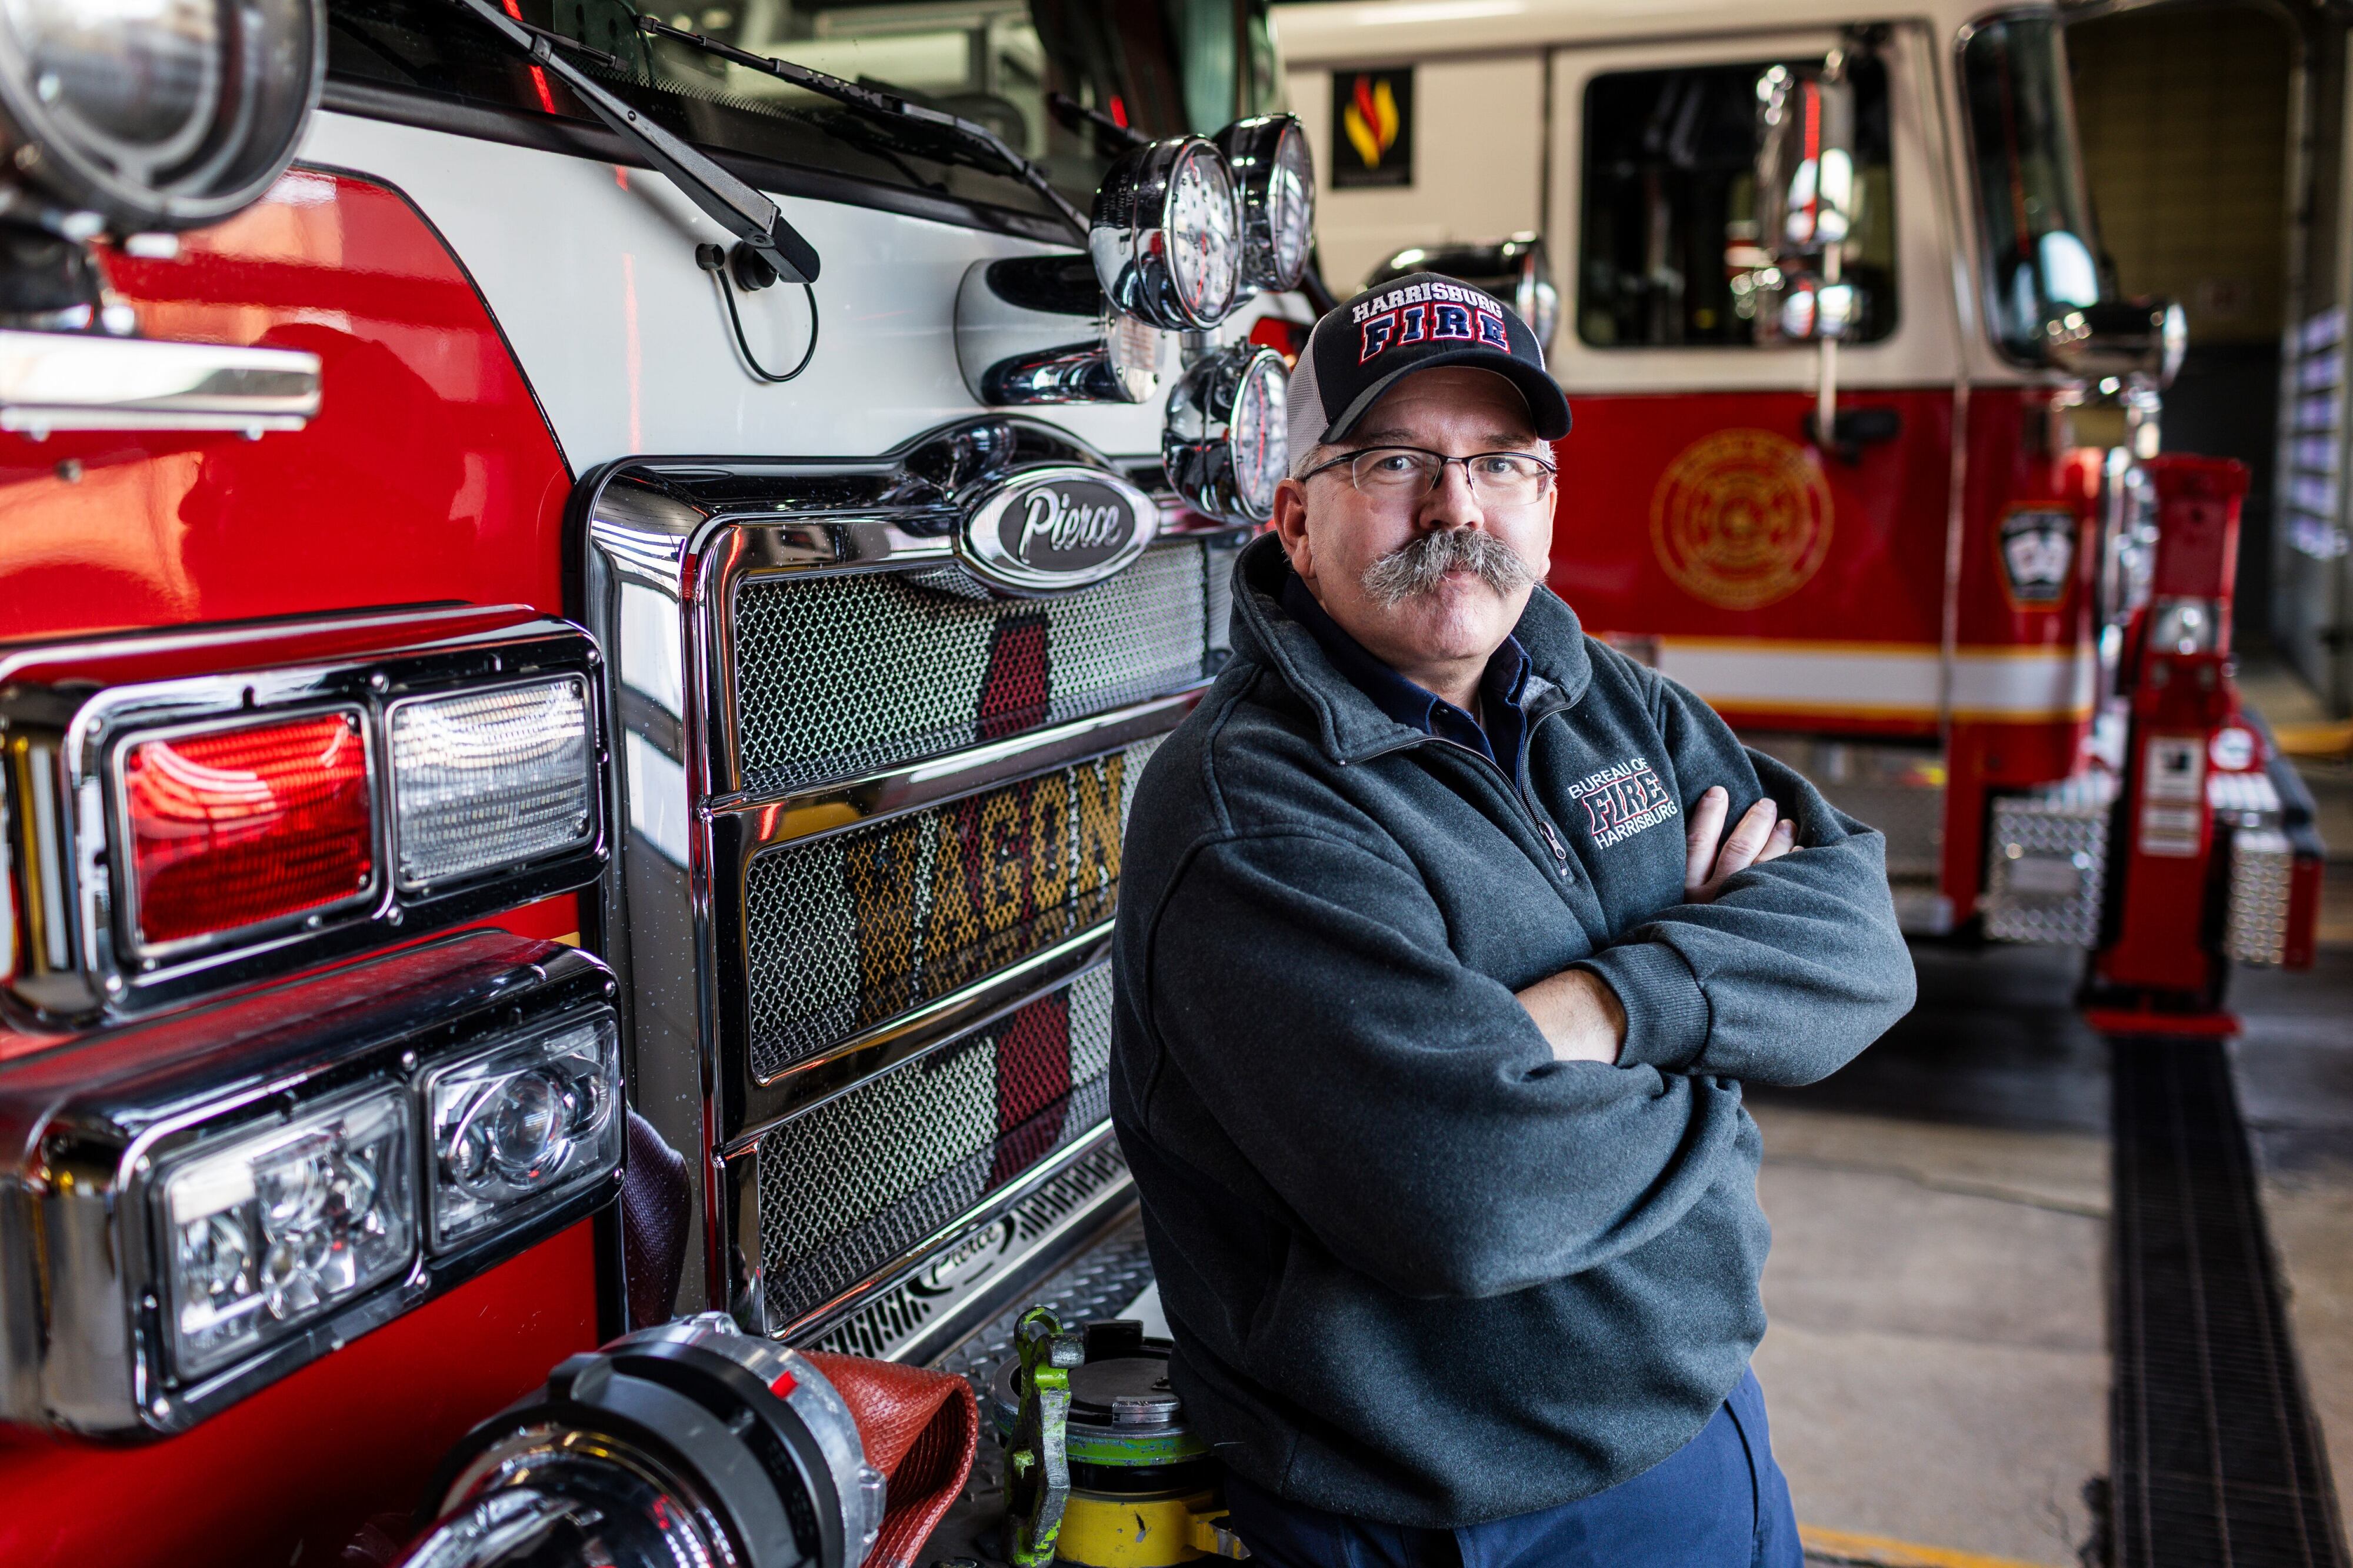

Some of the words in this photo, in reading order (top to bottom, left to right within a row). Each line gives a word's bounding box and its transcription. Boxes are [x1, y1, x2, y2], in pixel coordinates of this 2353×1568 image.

[1352, 282, 1502, 324] HARRISBURG
[1359, 302, 1511, 366] FIRE
[1018, 486, 1123, 565] Pierce
[1568, 762, 1632, 799] BUREAU
[1631, 757, 1648, 770] OF
[1581, 767, 1671, 836] FIRE
[1594, 800, 1678, 850] HARRISBURG
[846, 755, 1122, 988] WAGON
